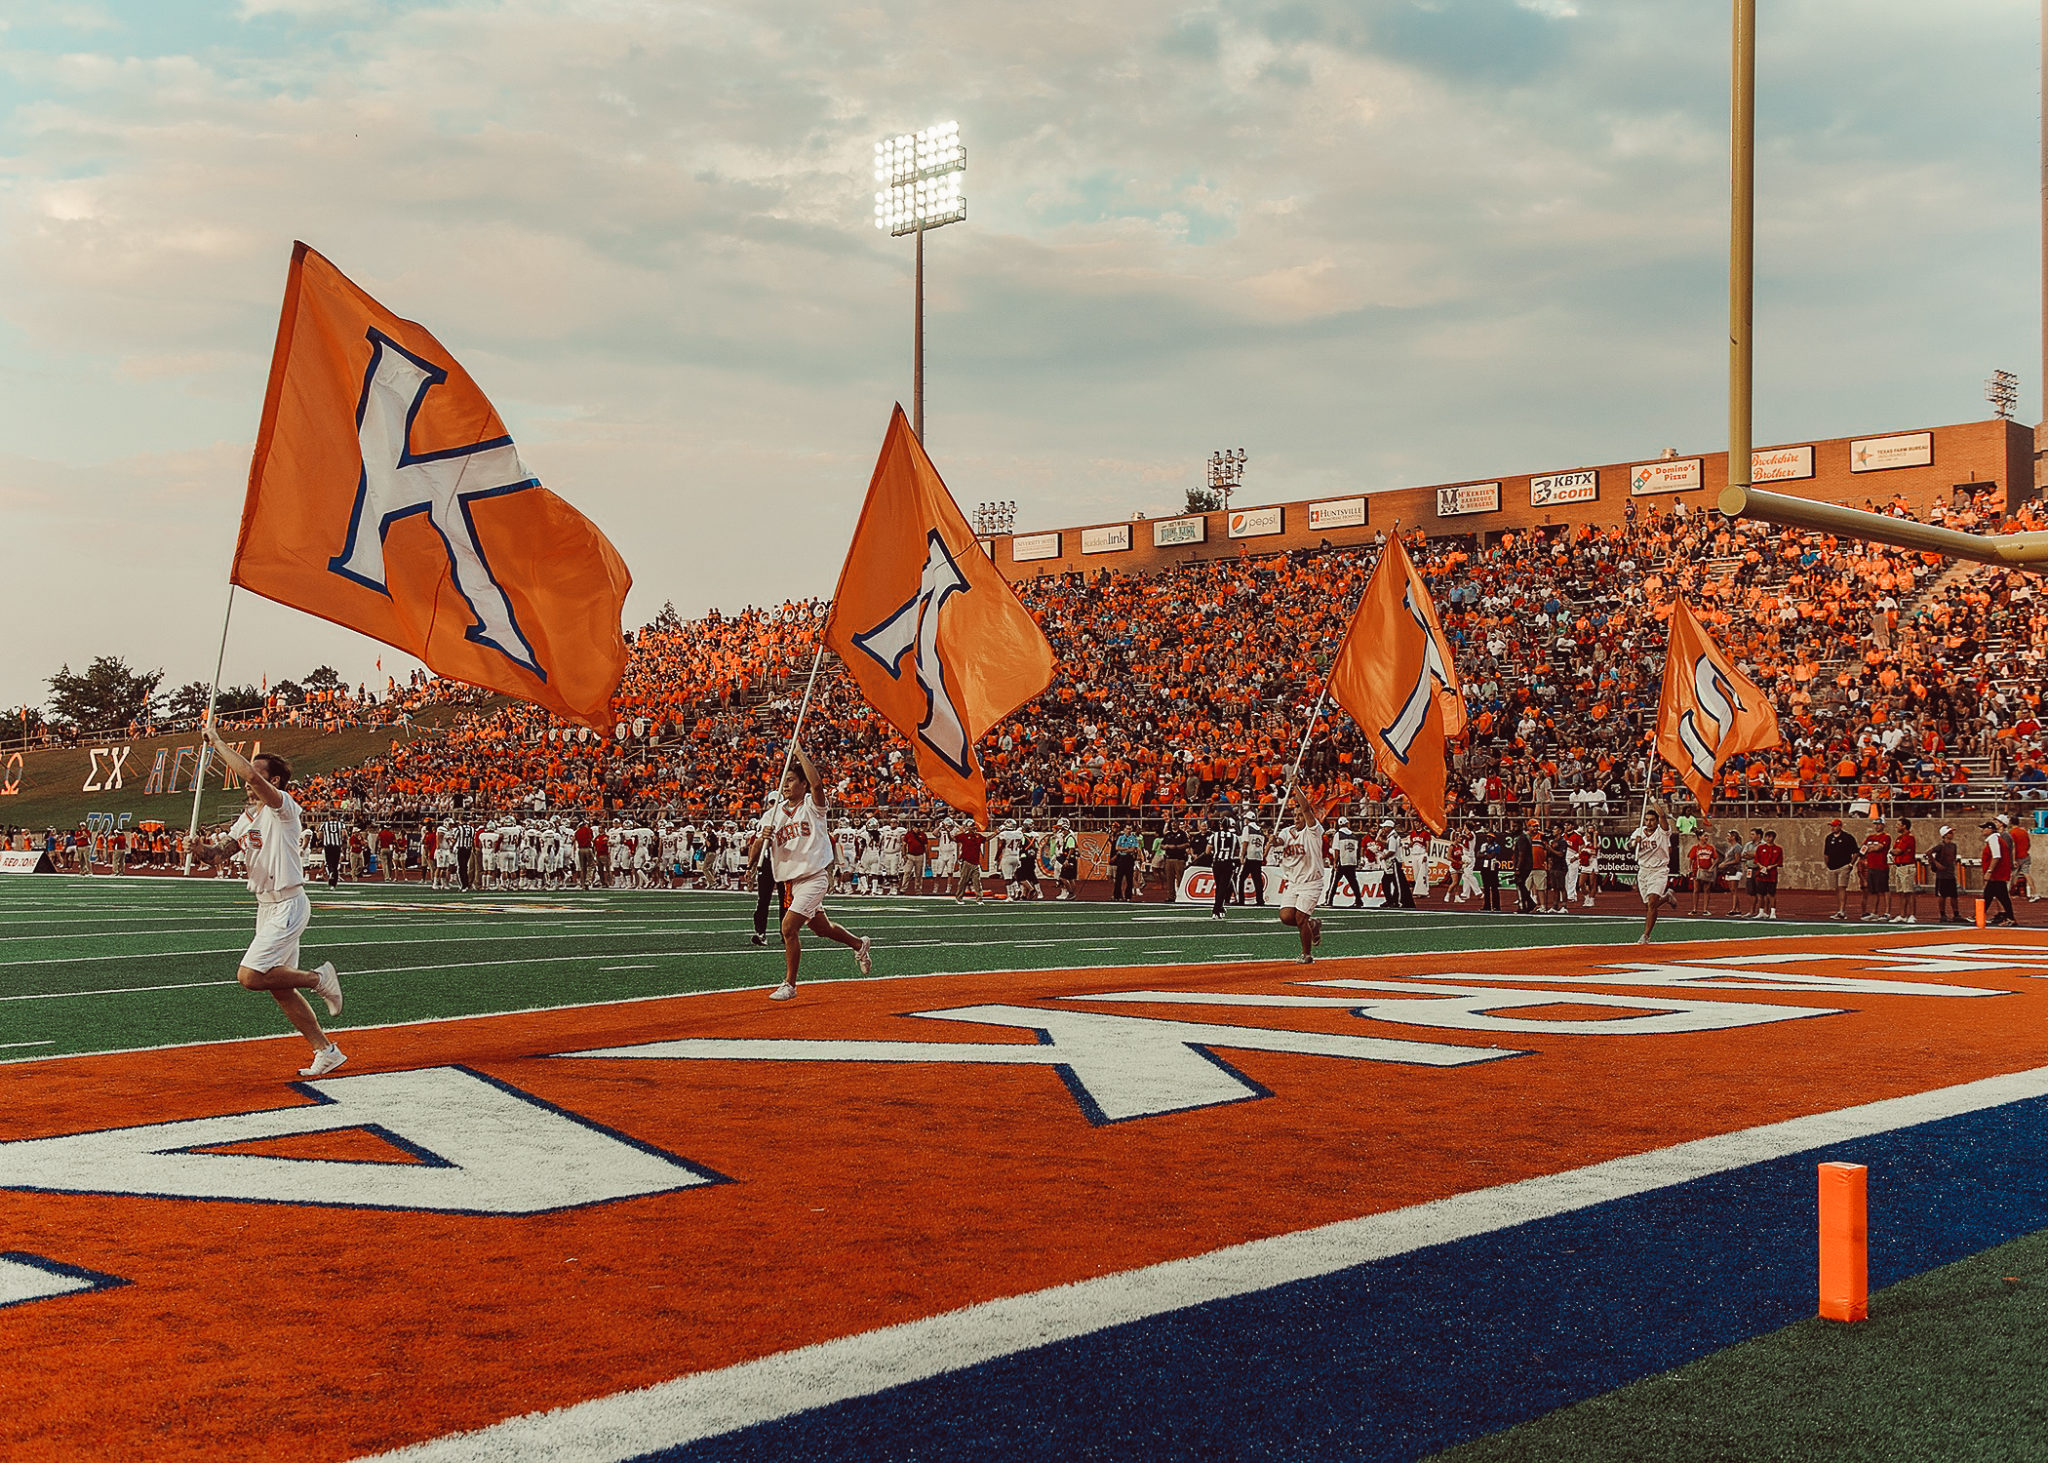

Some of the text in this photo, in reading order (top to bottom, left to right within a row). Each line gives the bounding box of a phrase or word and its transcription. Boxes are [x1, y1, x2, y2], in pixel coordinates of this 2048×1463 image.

[1752, 453, 1799, 466] Brookshire
[1655, 463, 1696, 475] Domino's
[1753, 468, 1796, 480] Brothers
[1553, 472, 1593, 487] KBTX
[1664, 473, 1687, 481] Pizza
[328, 325, 548, 682] K
[1320, 506, 1362, 517] HUNTSVILLE
[1248, 514, 1276, 528] pepsi
[841, 833, 854, 843] 92
[886, 837, 898, 850] 71
[483, 839, 493, 850] 13
[1599, 862, 1640, 871] oubledave
